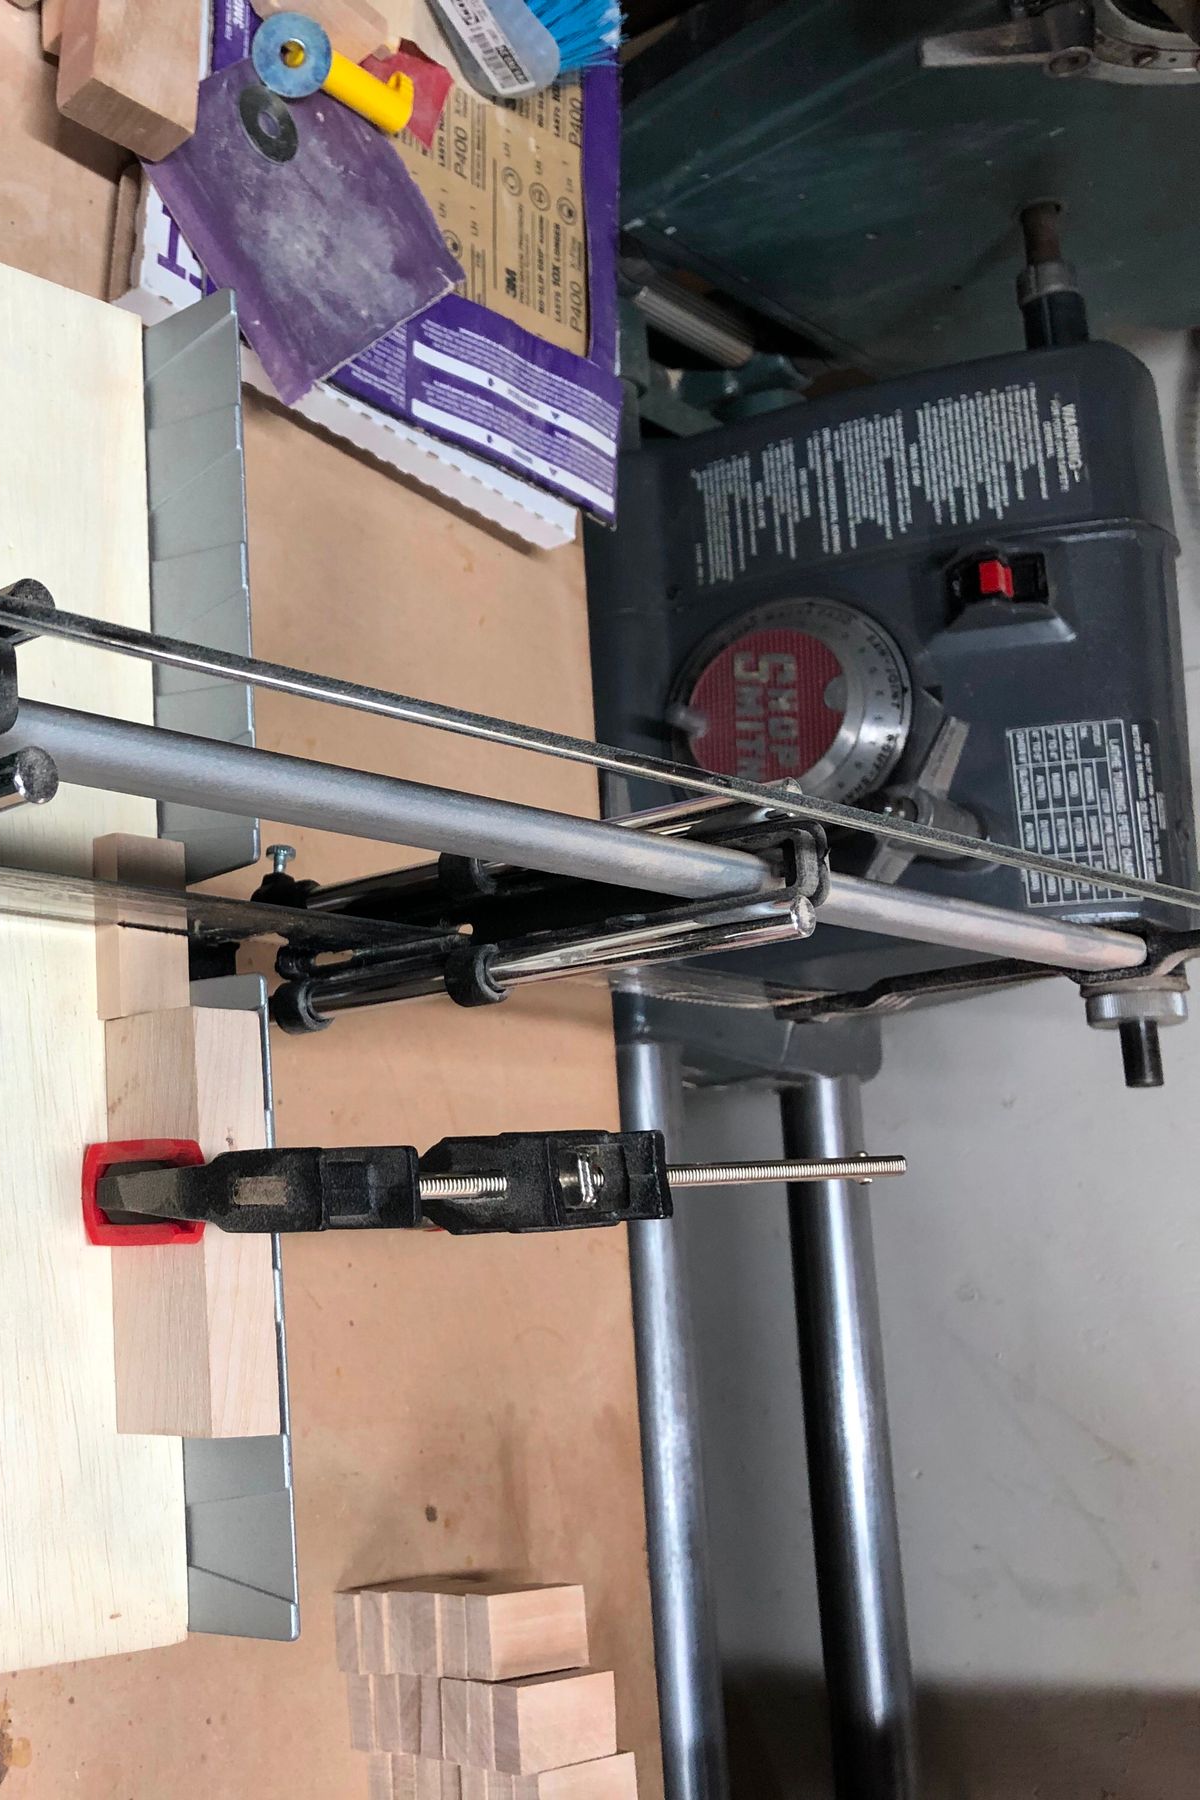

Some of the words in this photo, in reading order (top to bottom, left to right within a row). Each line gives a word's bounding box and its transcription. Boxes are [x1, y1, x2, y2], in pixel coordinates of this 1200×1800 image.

[568, 98, 583, 148] P400
[454, 126, 467, 179] P400
[505, 268, 517, 298] 3M
[552, 263, 560, 287] 10X
[569, 281, 582, 333] P400
[1109, 738, 1122, 769] LATHE
[1112, 771, 1127, 813] TURNING
[1118, 814, 1130, 846] SPEED
